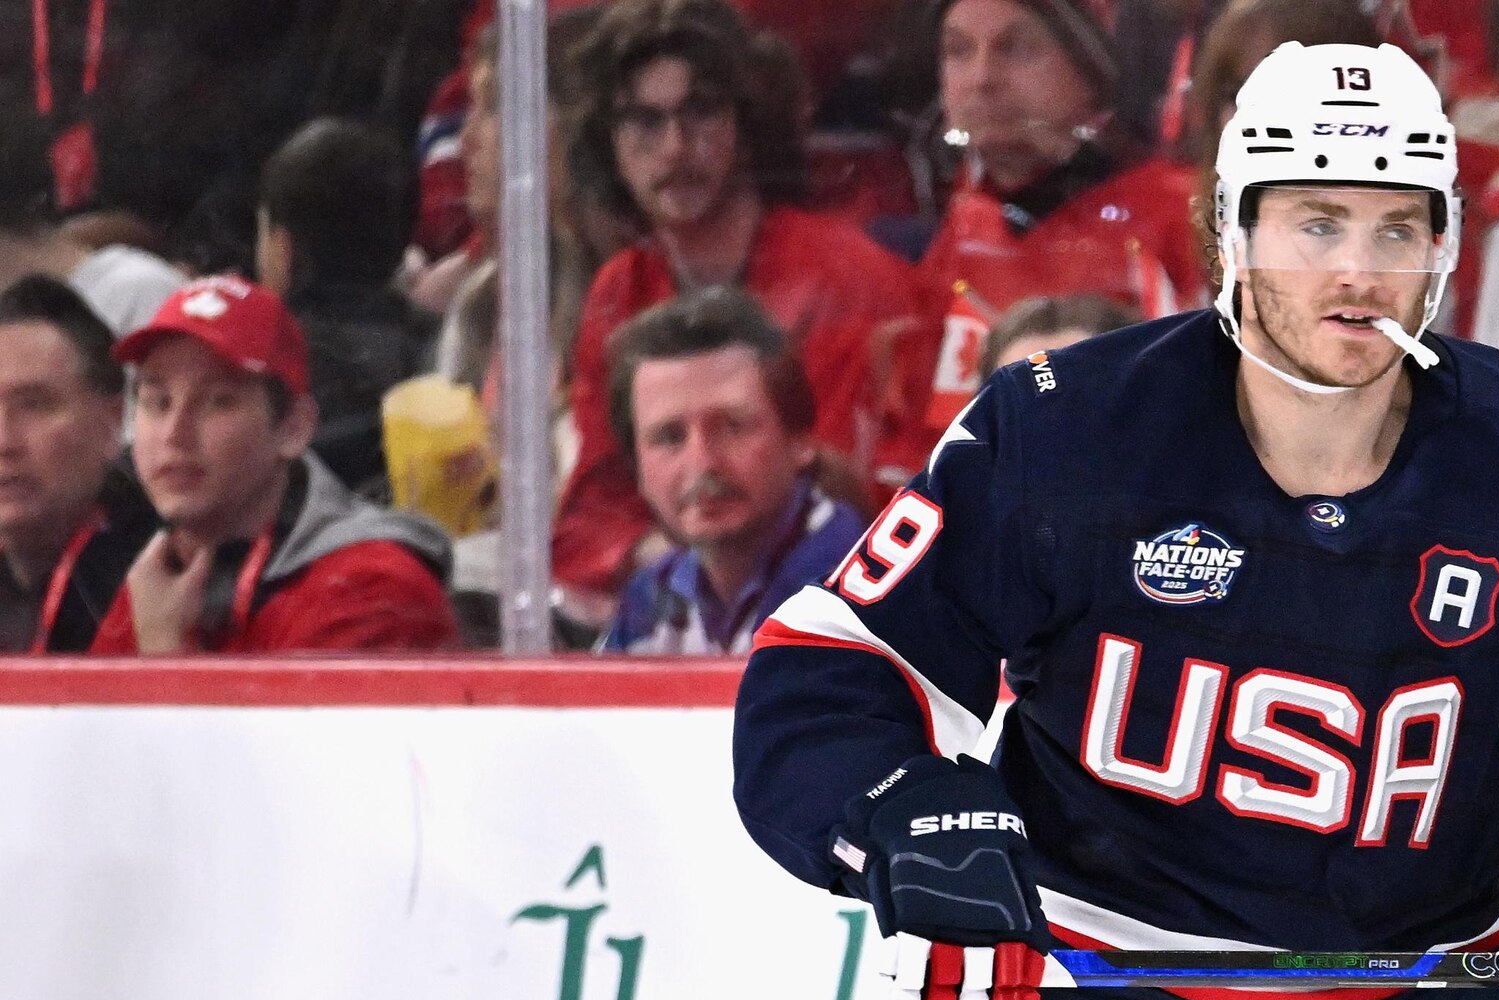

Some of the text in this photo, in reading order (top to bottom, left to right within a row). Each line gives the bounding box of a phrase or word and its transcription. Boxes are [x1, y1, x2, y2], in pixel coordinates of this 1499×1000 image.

[1331, 66, 1371, 91] 13
[1027, 350, 1057, 393] OVER
[1132, 540, 1245, 568] NATIONS
[1160, 580, 1188, 590] 2025
[1429, 563, 1482, 629] A
[1080, 632, 1466, 849] USA
[866, 767, 908, 800] TKACHUK
[910, 811, 1028, 840] SHER
[1369, 959, 1400, 969] PRO
